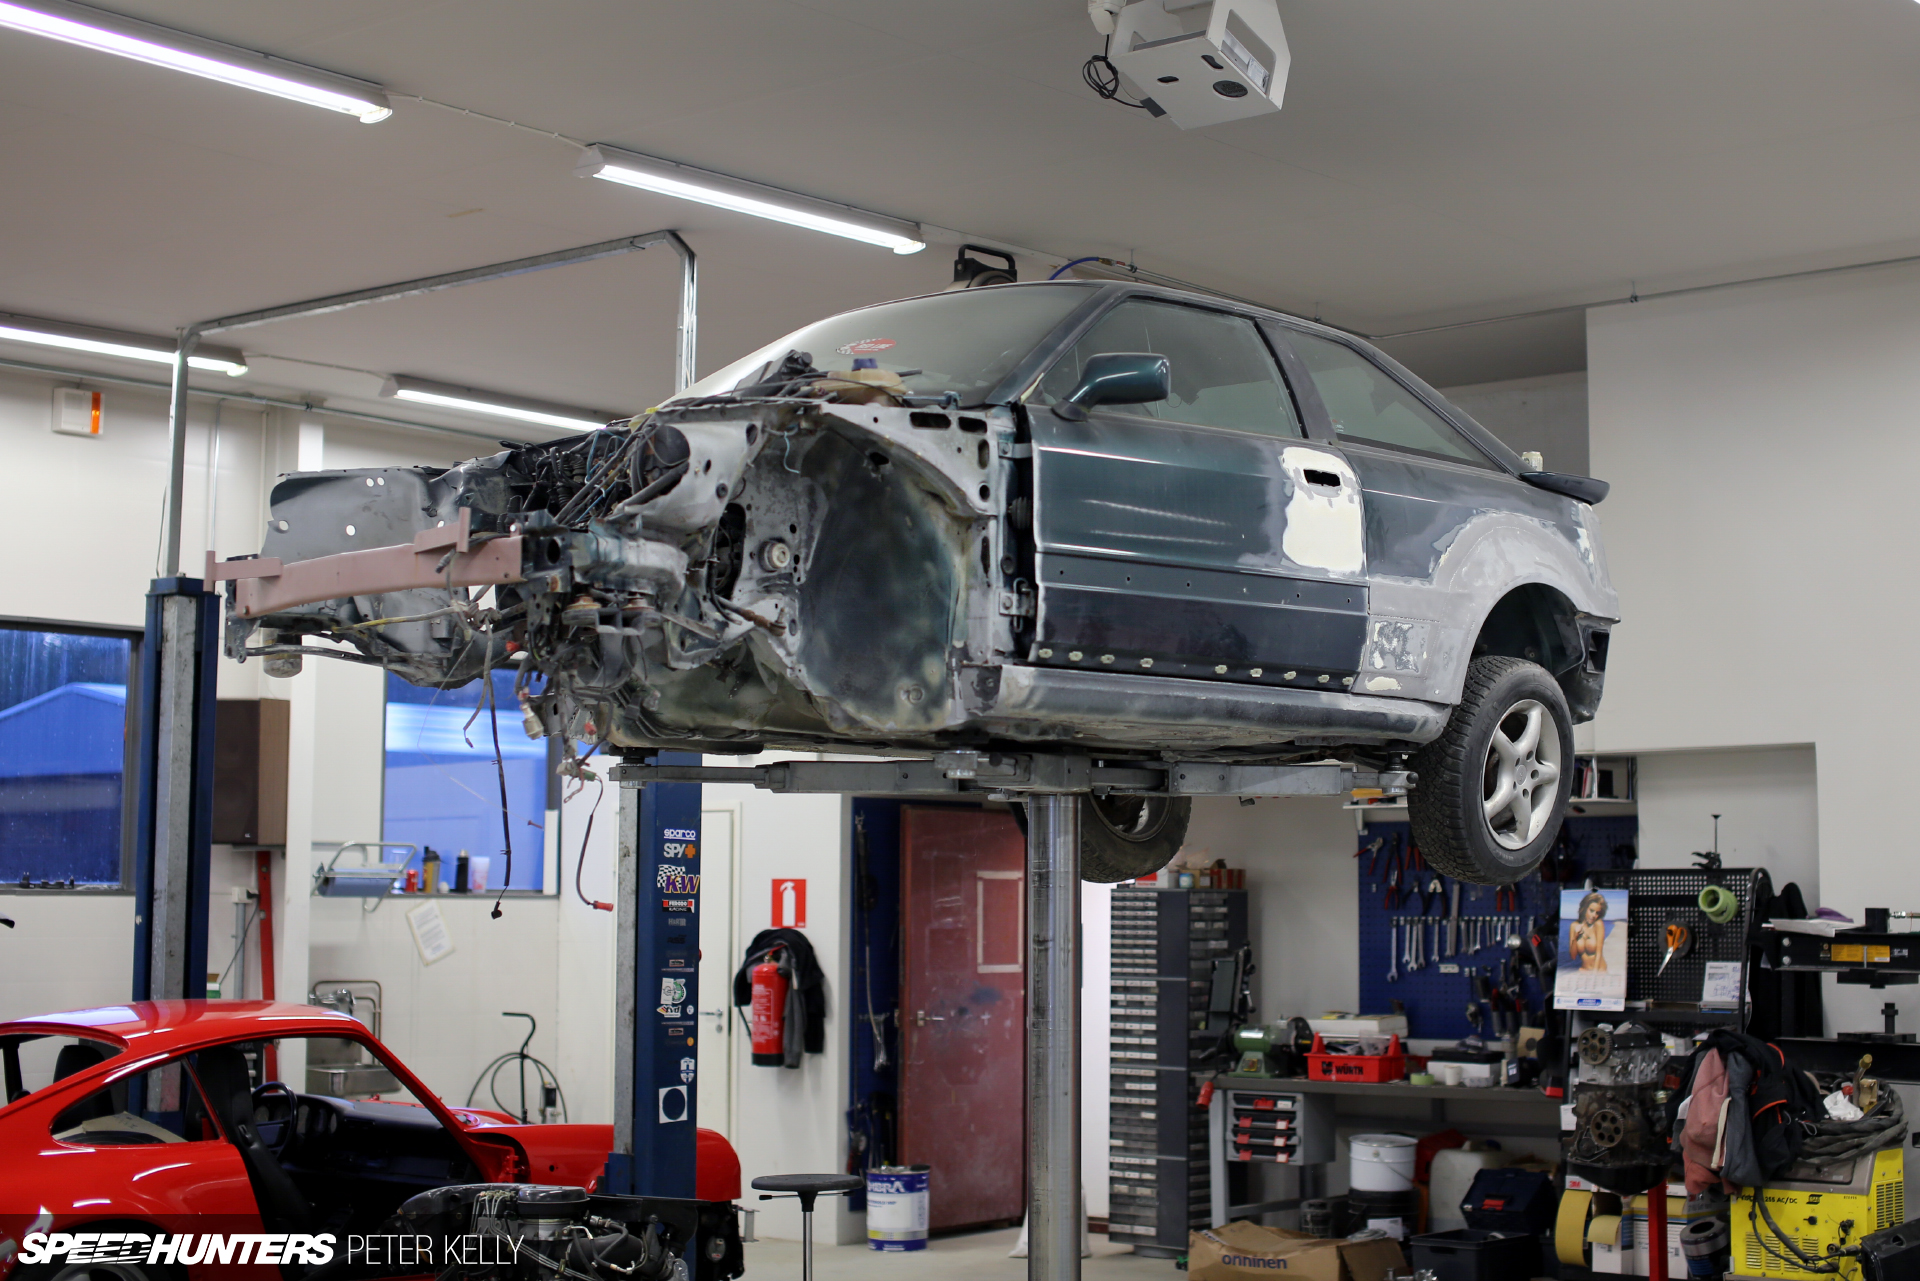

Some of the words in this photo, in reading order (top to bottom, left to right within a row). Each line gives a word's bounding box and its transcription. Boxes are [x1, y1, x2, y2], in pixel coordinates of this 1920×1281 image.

[663, 829, 696, 839] sparco
[663, 842, 686, 858] SPY
[664, 875, 700, 894] KW
[1335, 1063, 1364, 1075] WÜRTH
[1222, 1254, 1288, 1269] onninen
